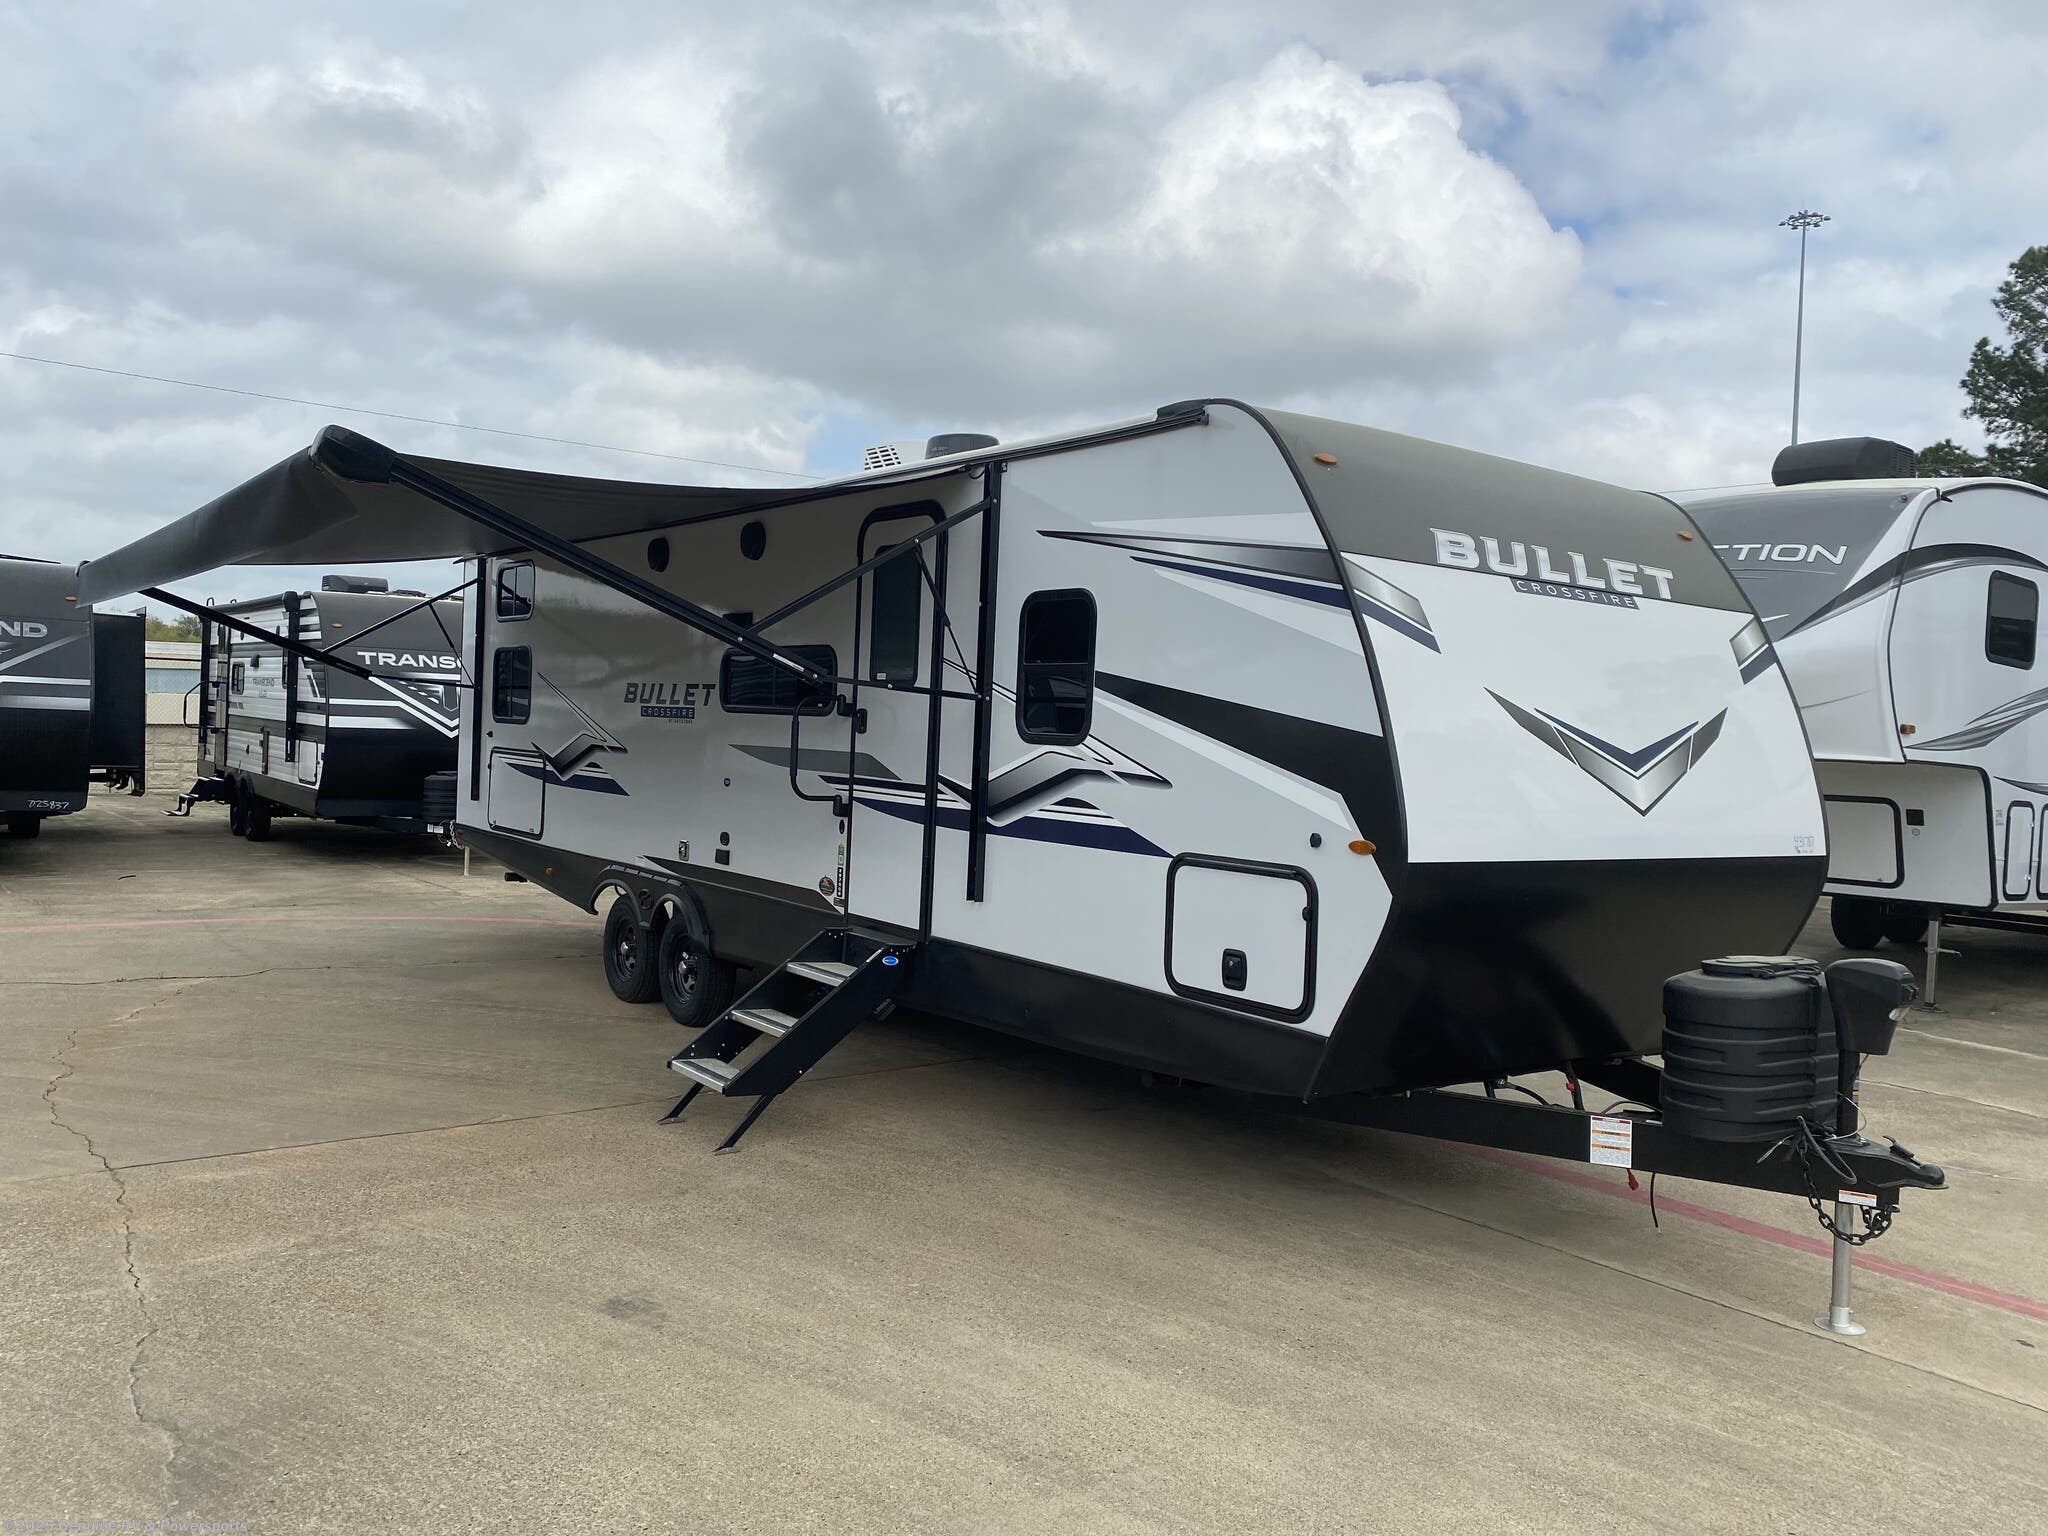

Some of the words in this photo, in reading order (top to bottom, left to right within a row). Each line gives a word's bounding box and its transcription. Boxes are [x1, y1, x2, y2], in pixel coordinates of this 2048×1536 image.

[1429, 527, 1674, 600] BULLET
[1515, 579, 1637, 609] CROSSFIRE
[623, 682, 717, 706] BULLET
[641, 707, 694, 719] CROSSFIRE
